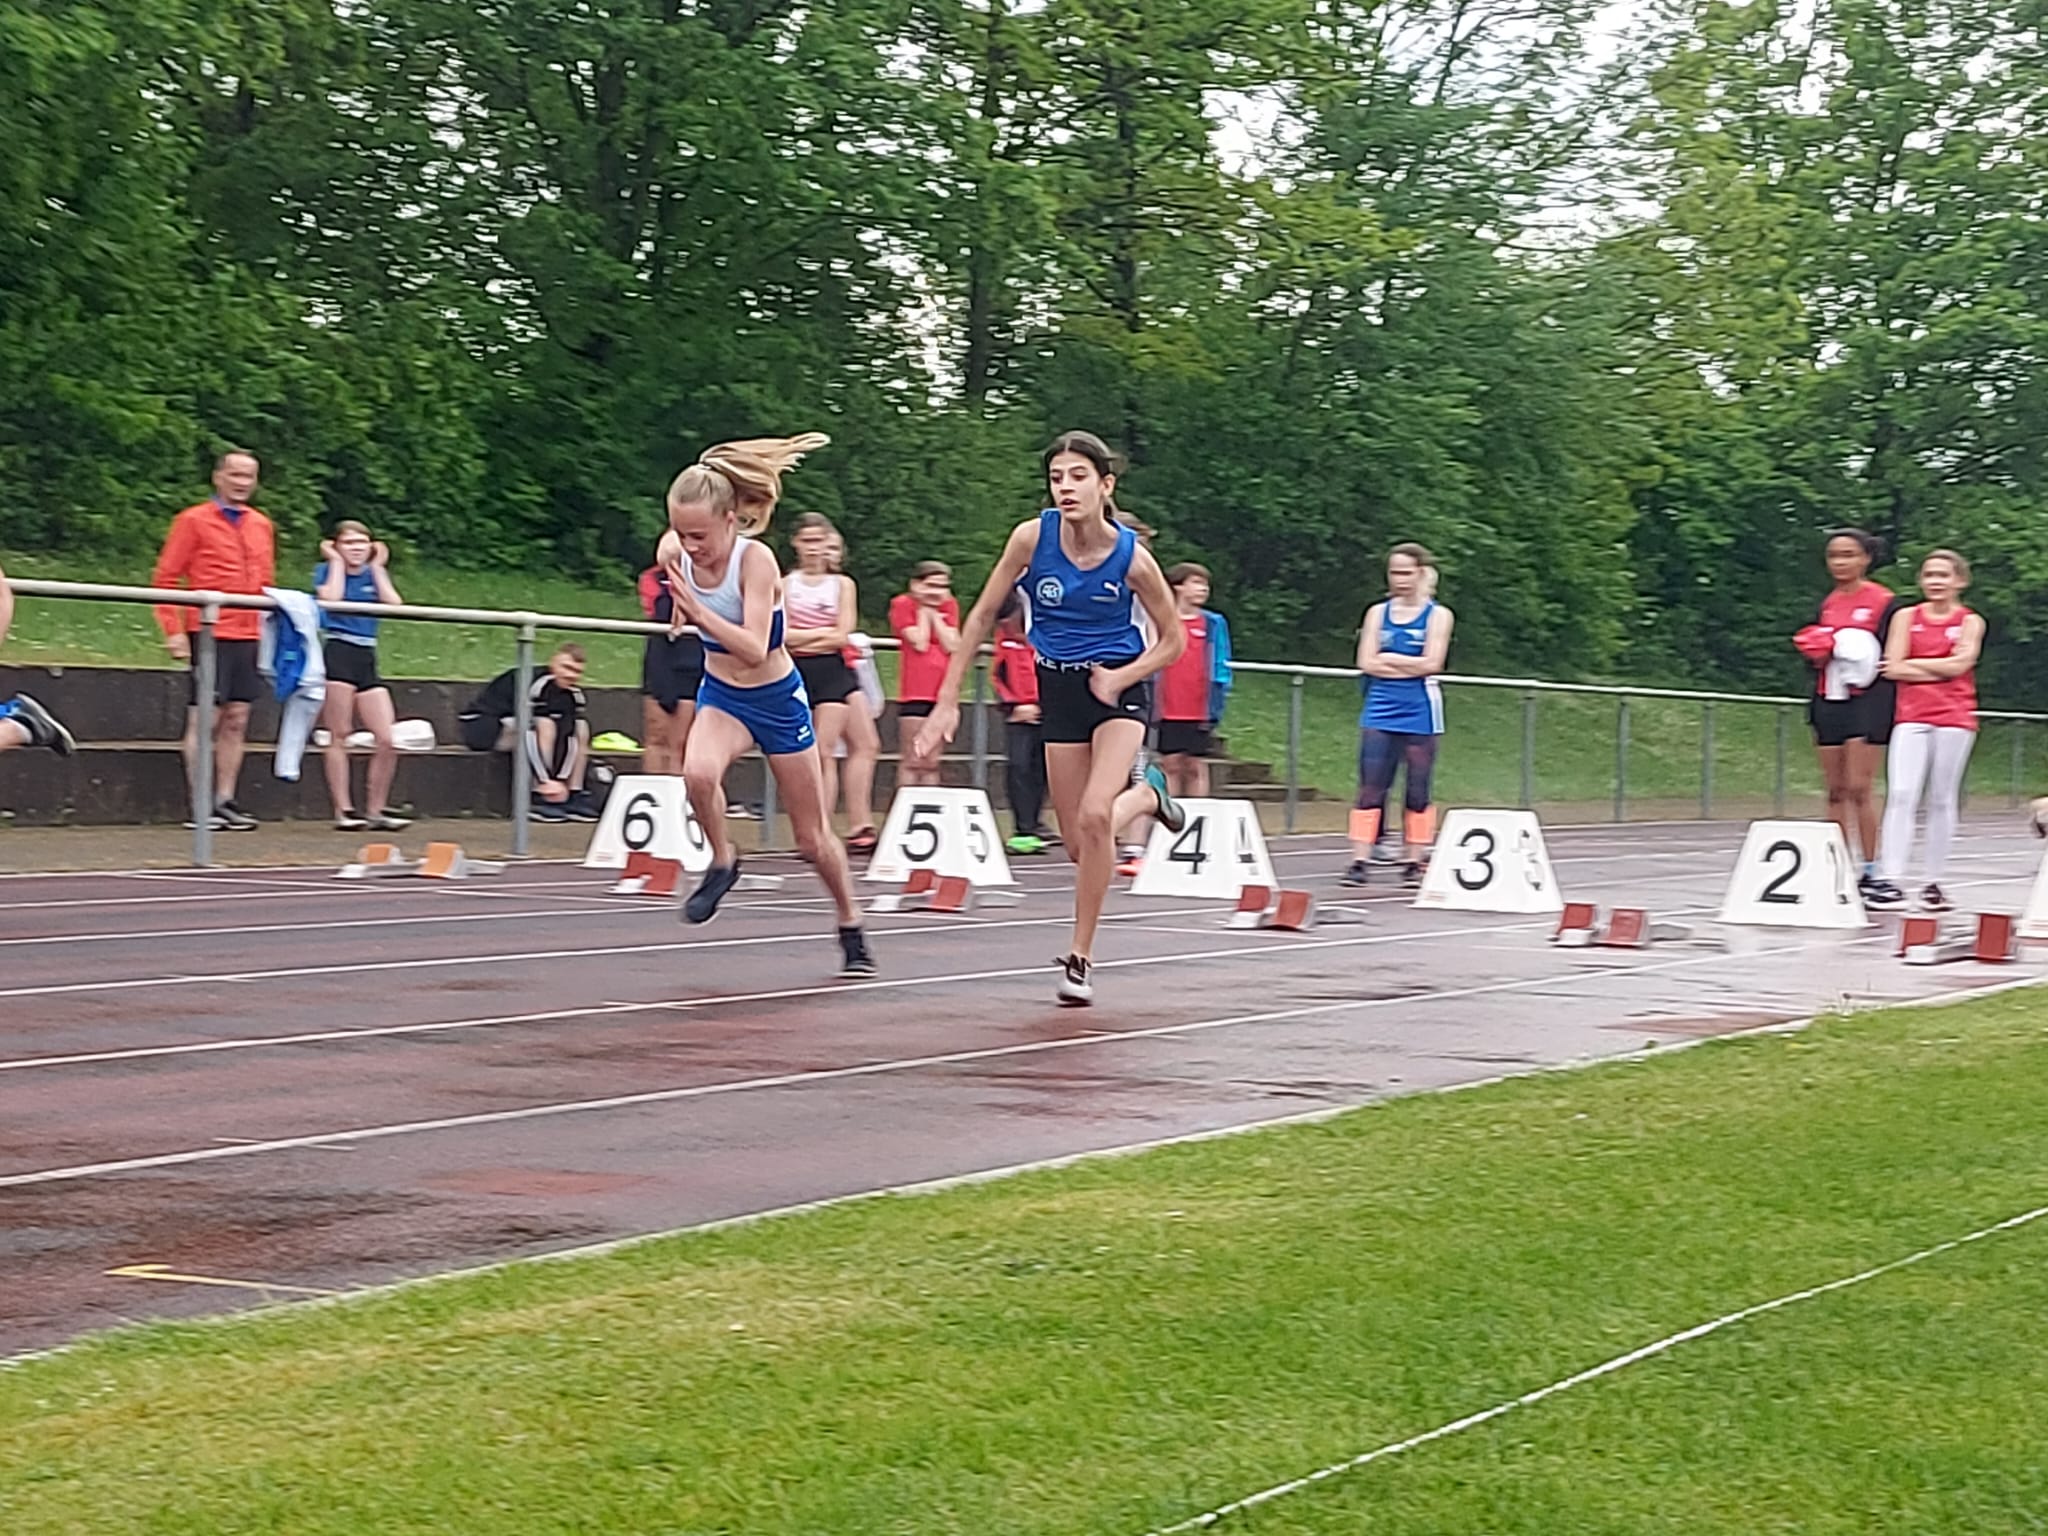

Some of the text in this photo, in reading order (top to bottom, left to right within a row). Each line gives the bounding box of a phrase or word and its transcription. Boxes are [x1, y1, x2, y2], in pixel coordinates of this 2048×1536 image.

[622, 793, 657, 850] 6
[901, 804, 943, 862] 5
[1167, 816, 1207, 874] 4
[1454, 828, 1494, 890] 3
[1759, 840, 1801, 904] 2
